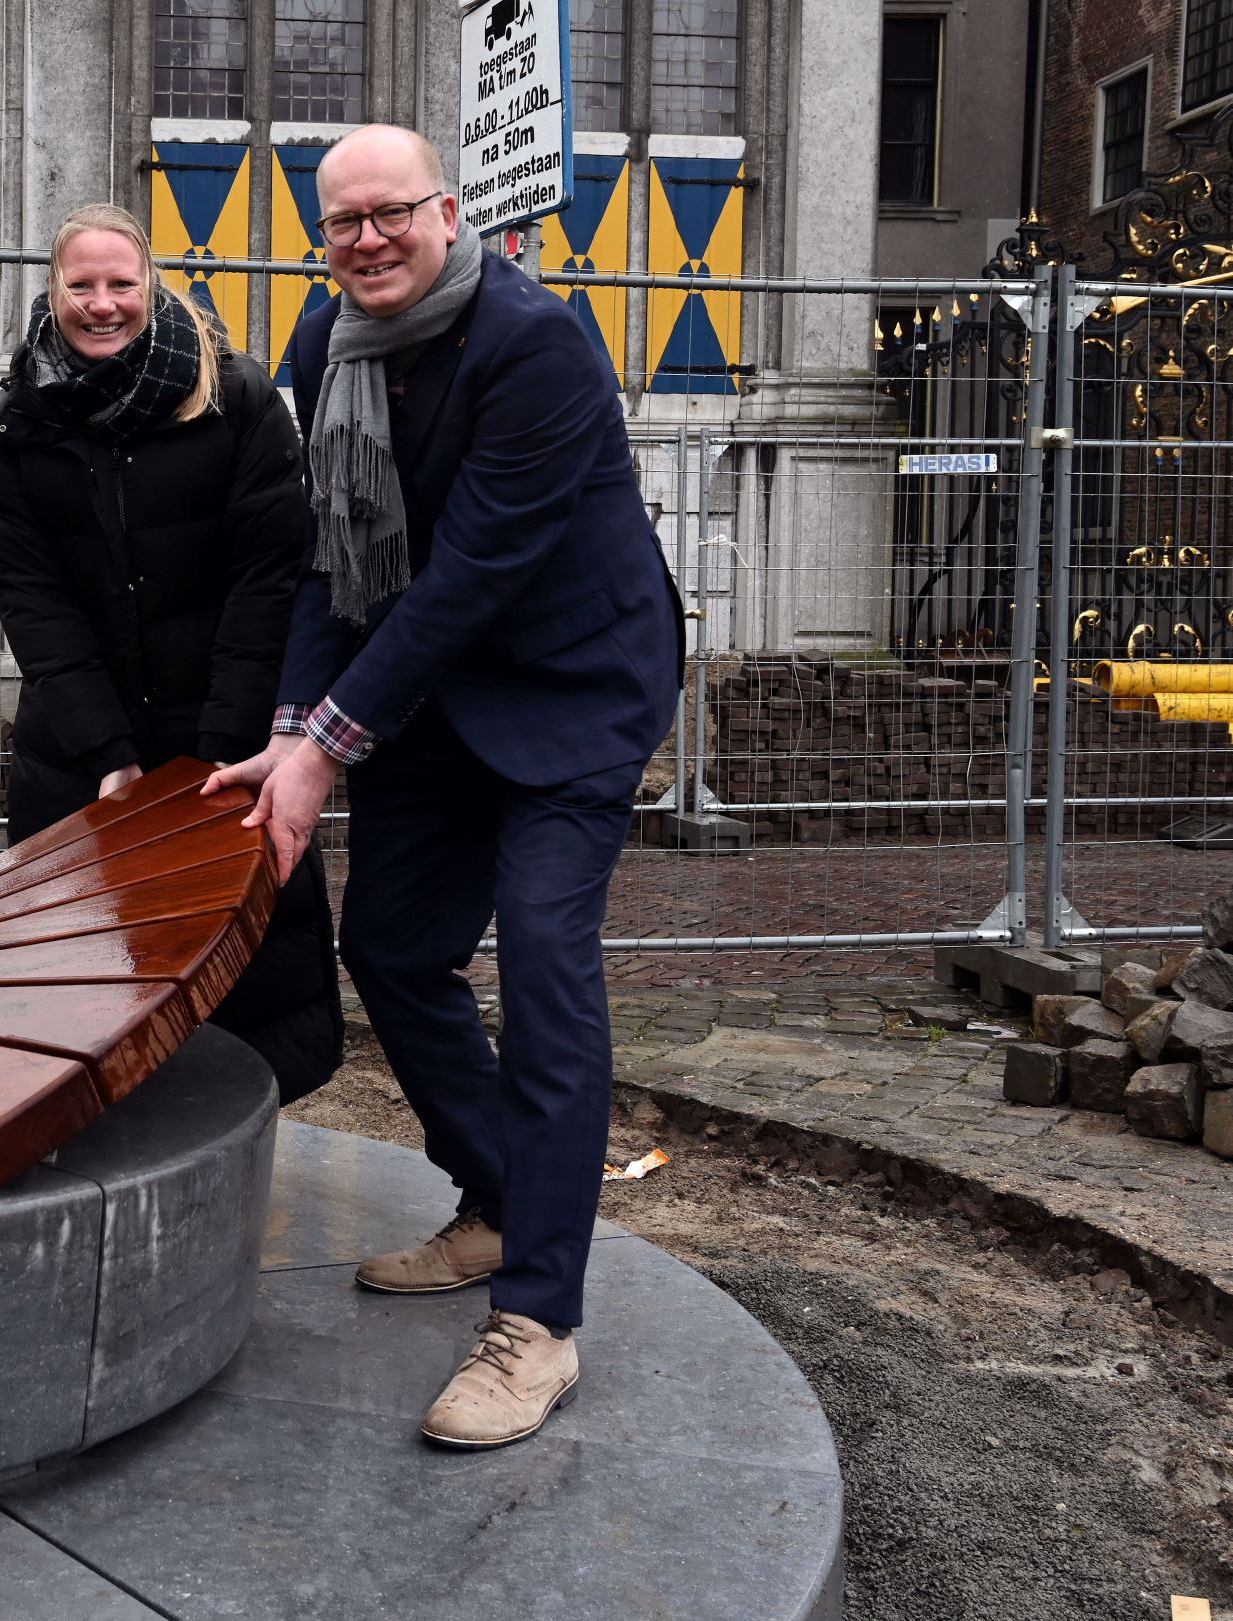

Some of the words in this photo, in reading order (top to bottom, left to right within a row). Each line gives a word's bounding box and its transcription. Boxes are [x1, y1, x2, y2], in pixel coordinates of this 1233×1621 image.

[479, 33, 537, 78] toegestaan
[478, 75, 495, 102] MA
[499, 67, 516, 91] t/m
[519, 52, 535, 80] ZO
[508, 84, 549, 123] 11.00h
[481, 143, 499, 167] na
[503, 125, 535, 156] 50m
[462, 177, 495, 205] Fietsen
[497, 151, 561, 188] toegestaan
[495, 183, 556, 214] werktijden
[908, 455, 982, 472] HERAS
